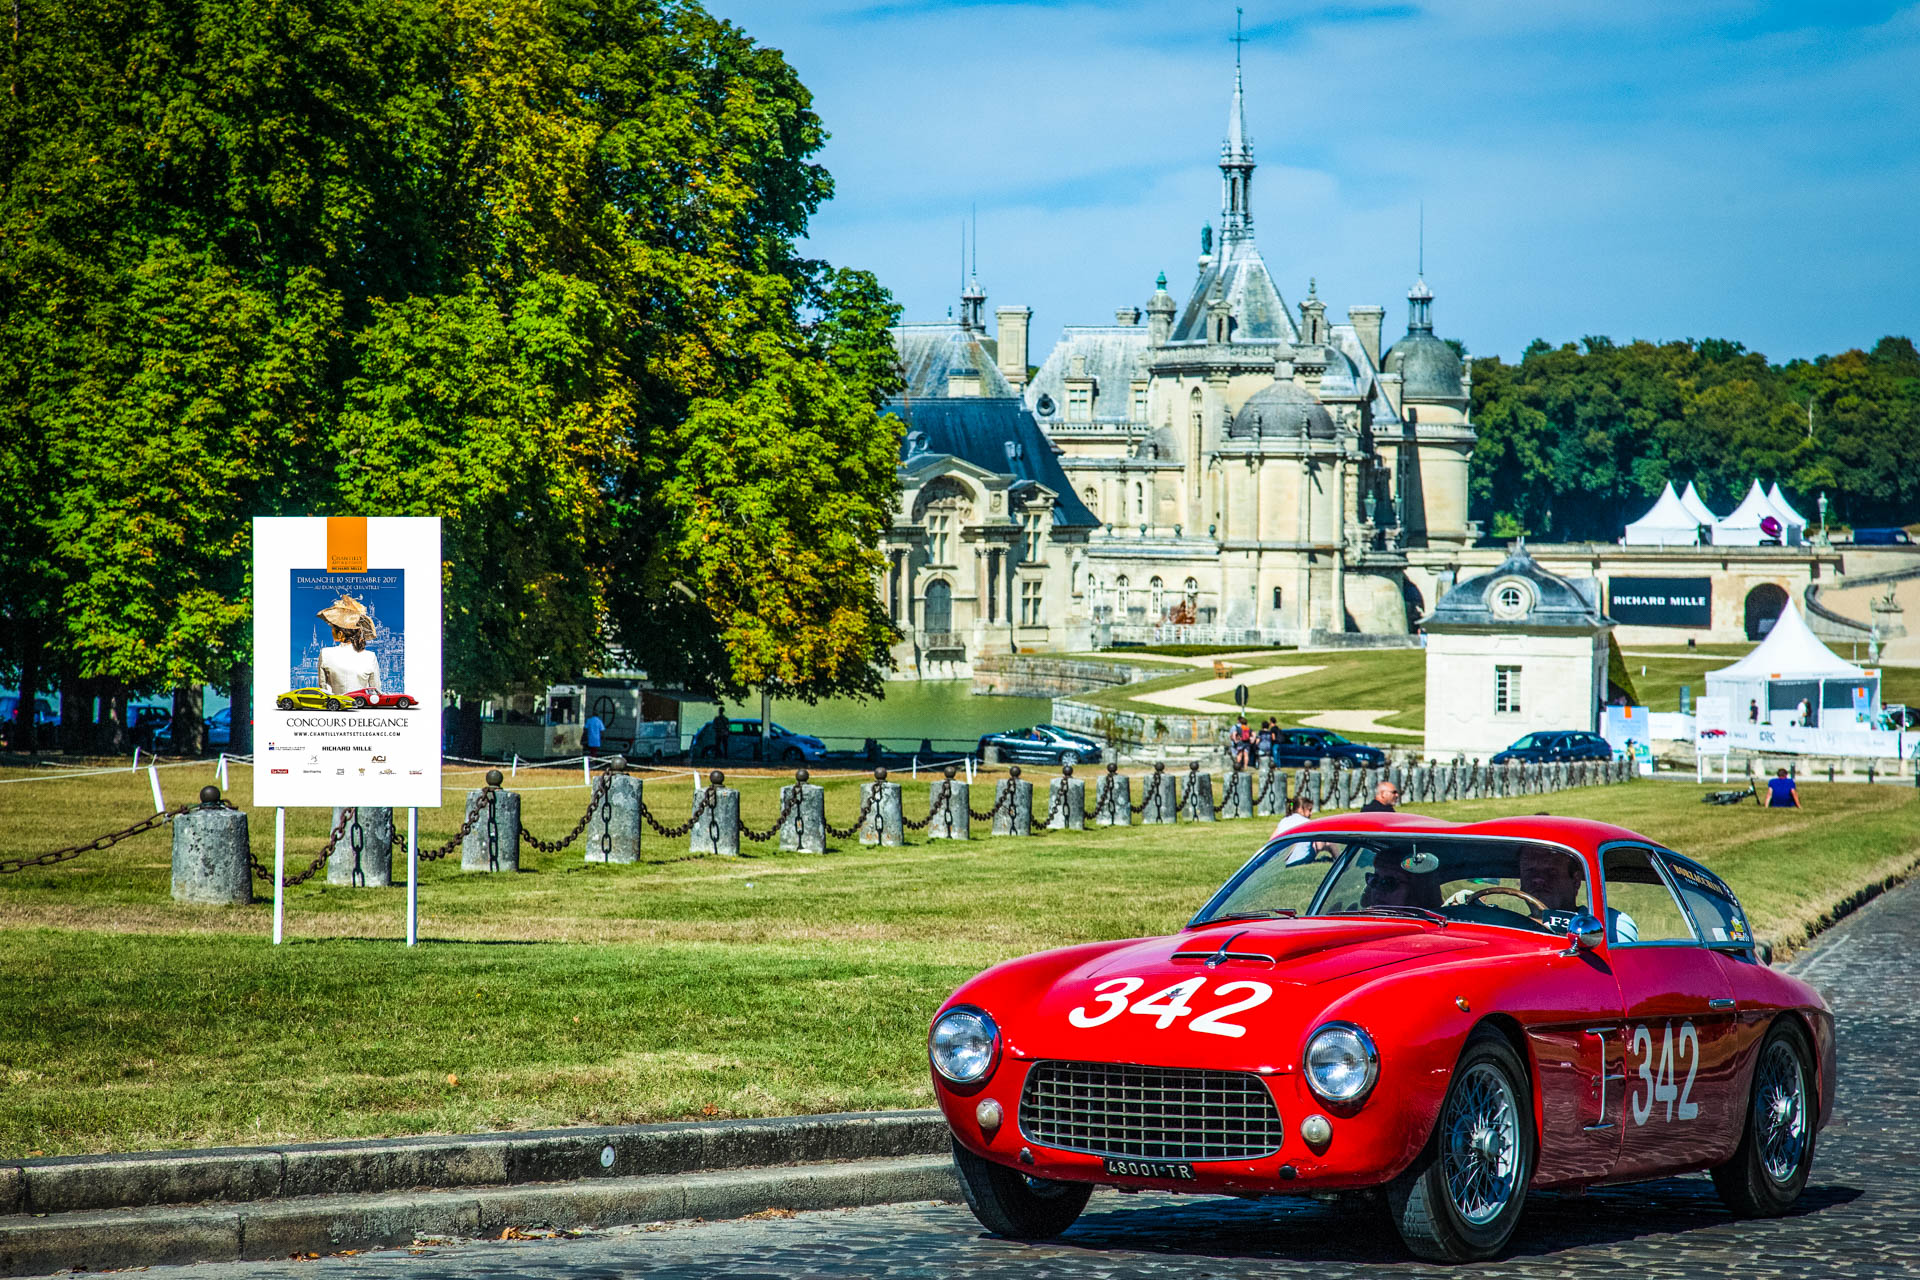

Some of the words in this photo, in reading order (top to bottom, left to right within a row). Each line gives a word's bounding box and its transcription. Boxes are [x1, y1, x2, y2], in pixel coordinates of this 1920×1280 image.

[297, 576, 335, 584] DIMANCHE
[336, 576, 344, 584] 10
[345, 576, 381, 584] SEPTEMBRE
[383, 576, 397, 584] 2017
[1613, 596, 1665, 606] RICHARD
[1670, 596, 1706, 606] MILLE
[286, 717, 347, 727] CONCOURS
[1068, 976, 1273, 1038] 342
[1632, 1021, 1699, 1127] 342
[1166, 1164, 1191, 1179] TR
